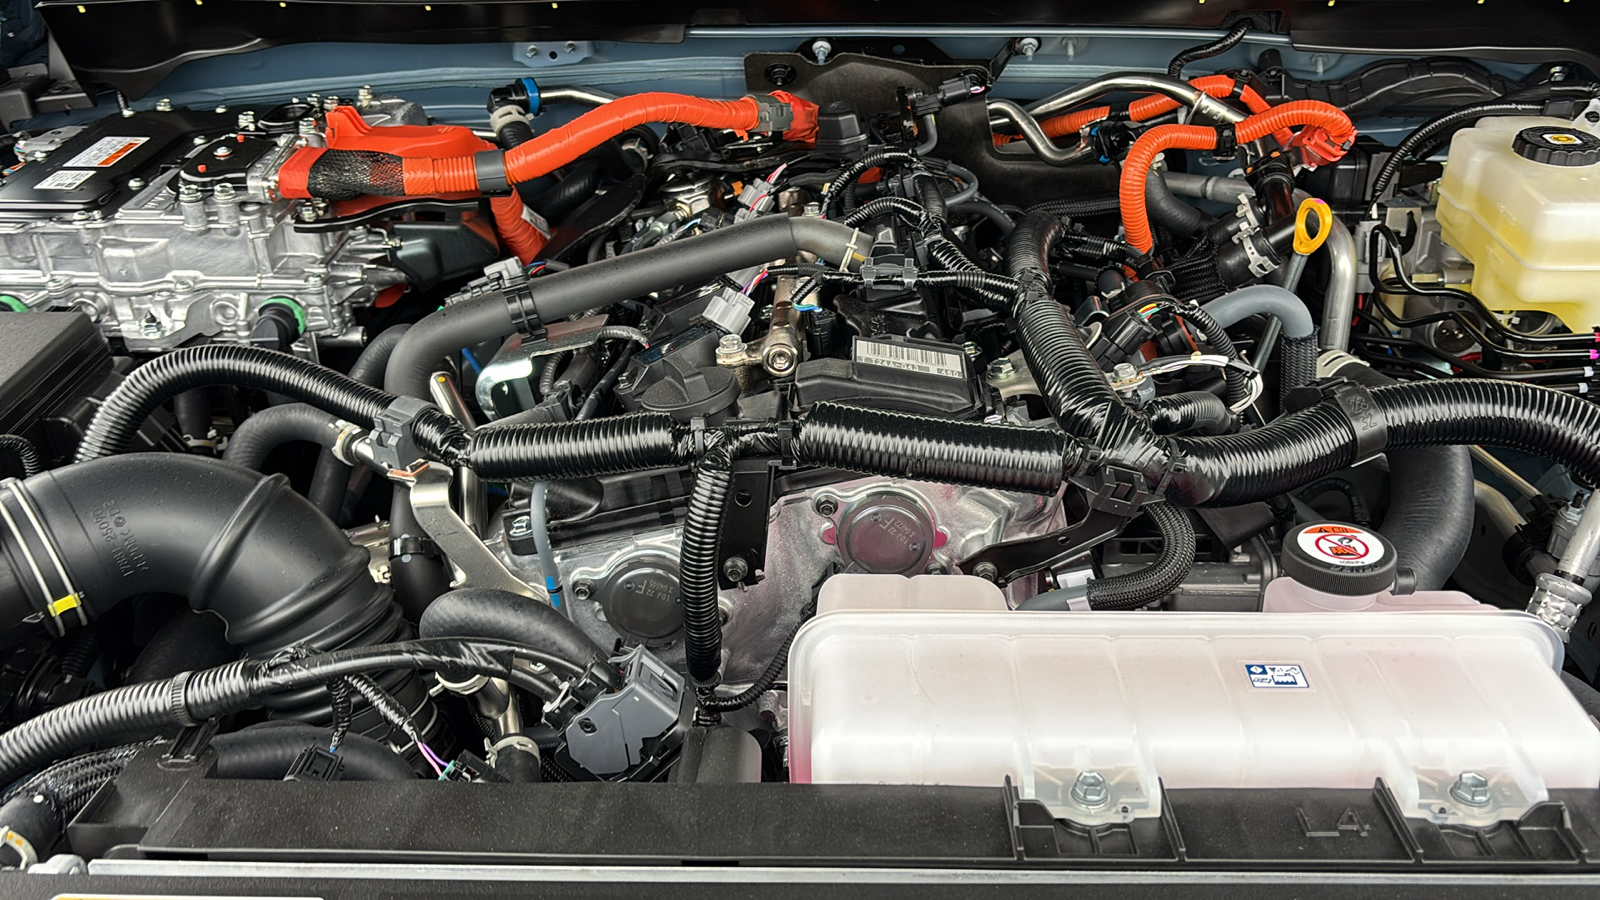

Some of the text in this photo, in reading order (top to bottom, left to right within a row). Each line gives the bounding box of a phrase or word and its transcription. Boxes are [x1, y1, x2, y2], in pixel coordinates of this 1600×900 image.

[879, 517, 895, 530] F
[635, 579, 647, 595] F
[646, 588, 655, 597] 22
[1296, 806, 1371, 837] L4
